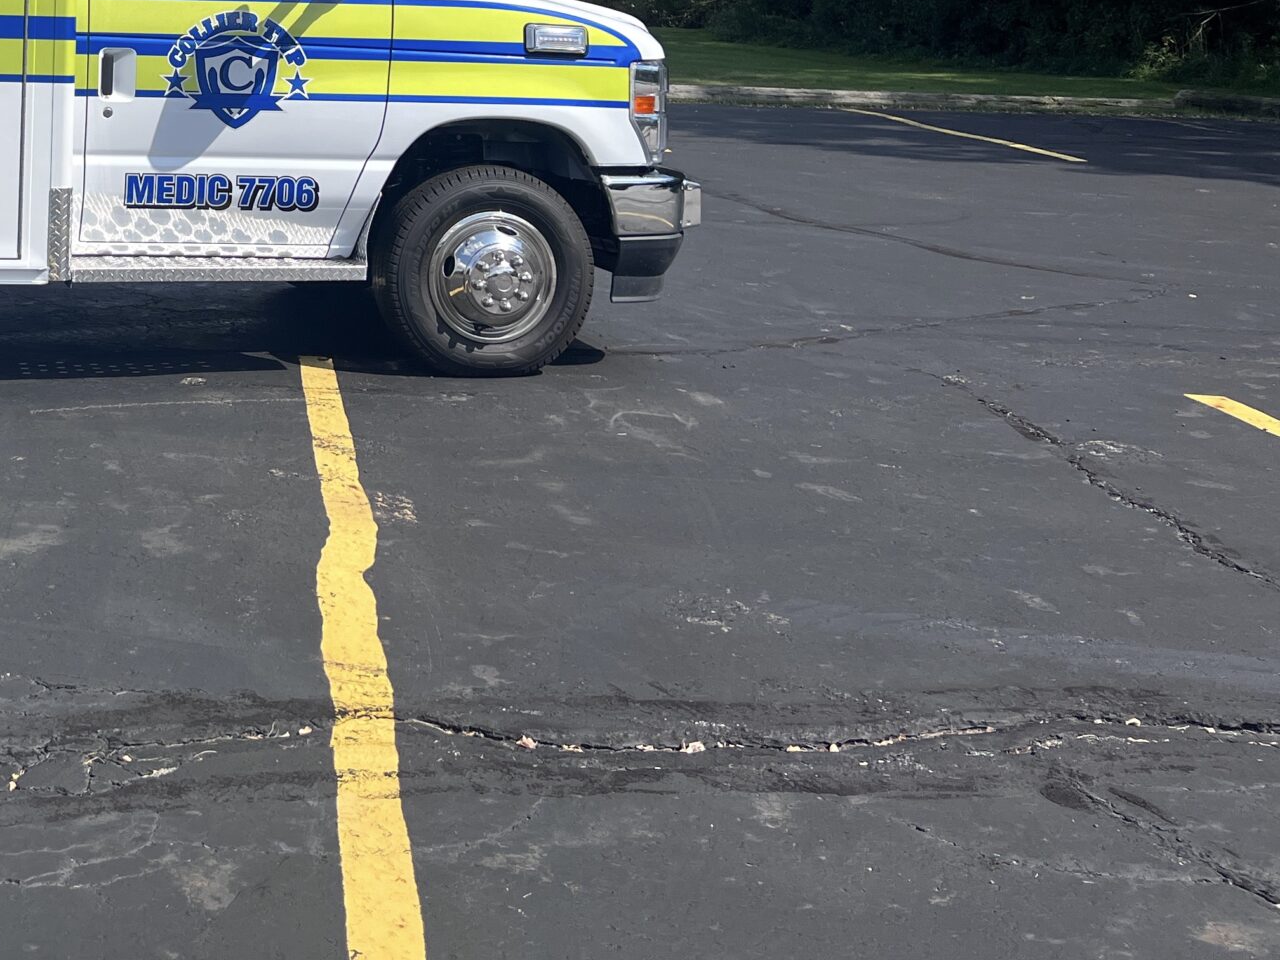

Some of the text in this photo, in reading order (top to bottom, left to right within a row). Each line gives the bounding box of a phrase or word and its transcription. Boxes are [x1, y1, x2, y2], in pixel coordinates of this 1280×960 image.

[168, 10, 259, 69] COLLIER
[220, 55, 254, 91] C
[124, 172, 320, 210] MEDIC 7706
